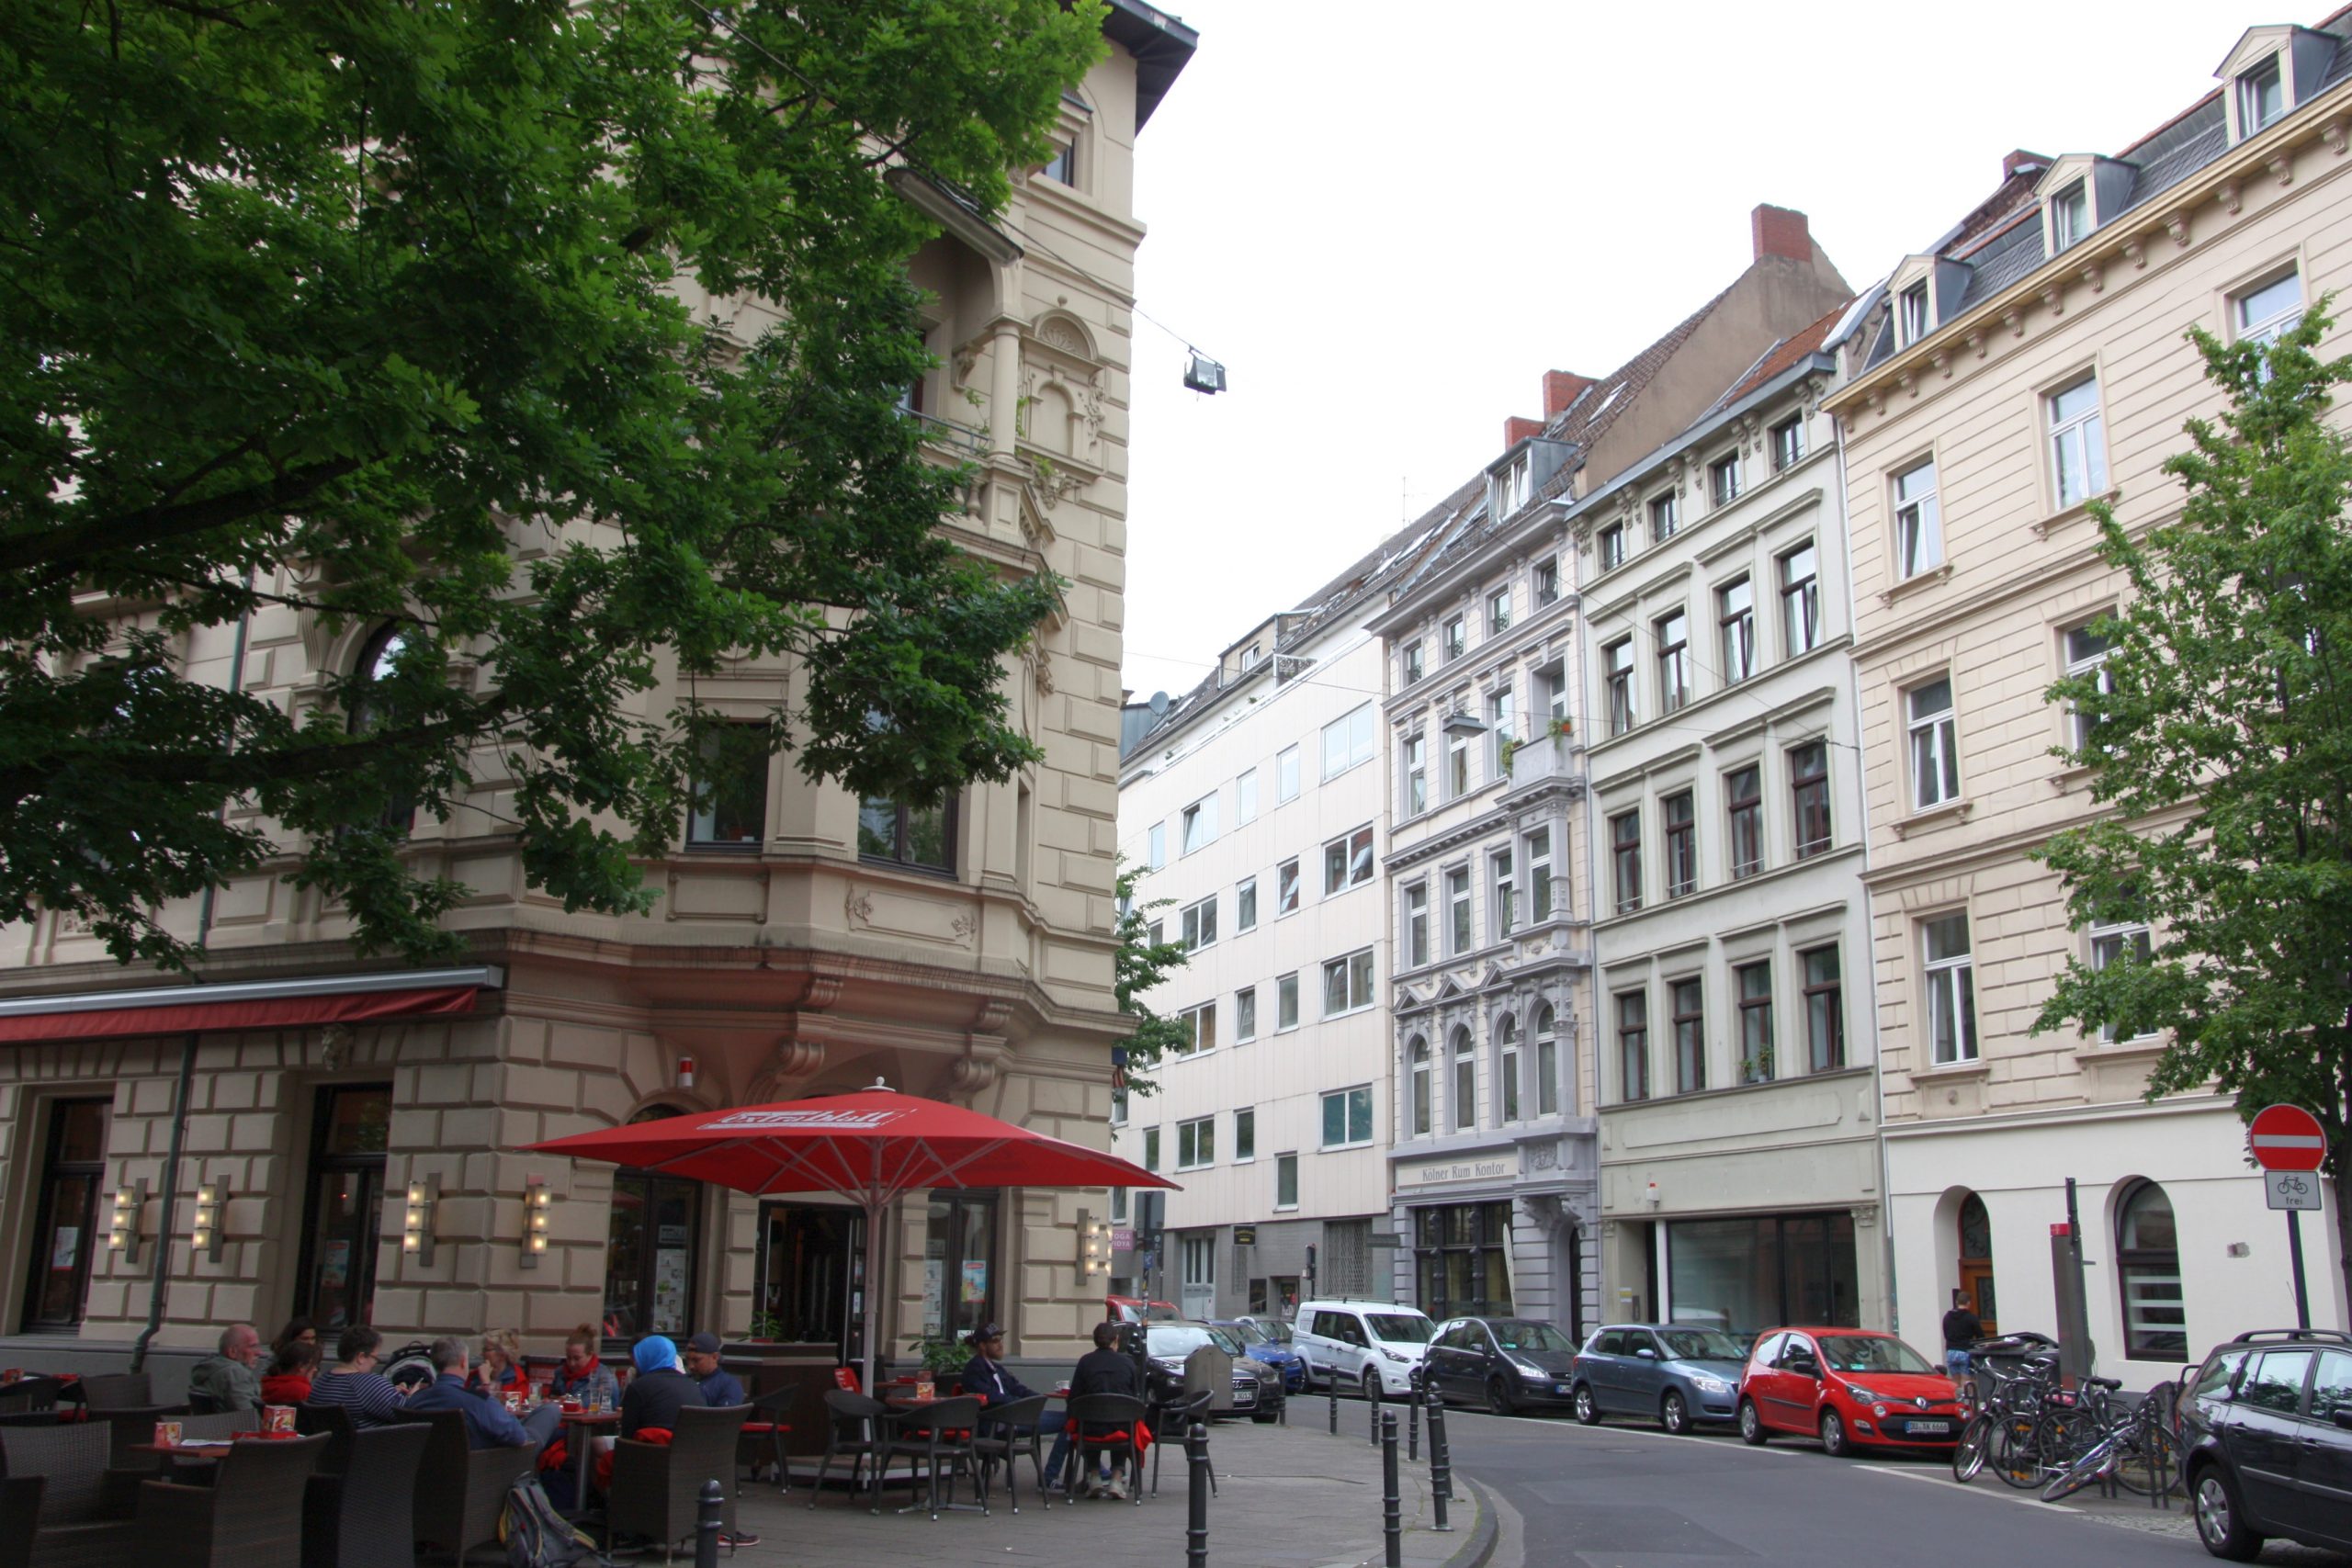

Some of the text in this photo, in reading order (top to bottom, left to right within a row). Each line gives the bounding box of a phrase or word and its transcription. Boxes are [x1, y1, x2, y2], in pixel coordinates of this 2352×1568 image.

[1422, 1162, 1505, 1182] Kölner Rum Kontor
[2286, 1196, 2302, 1205] frei
